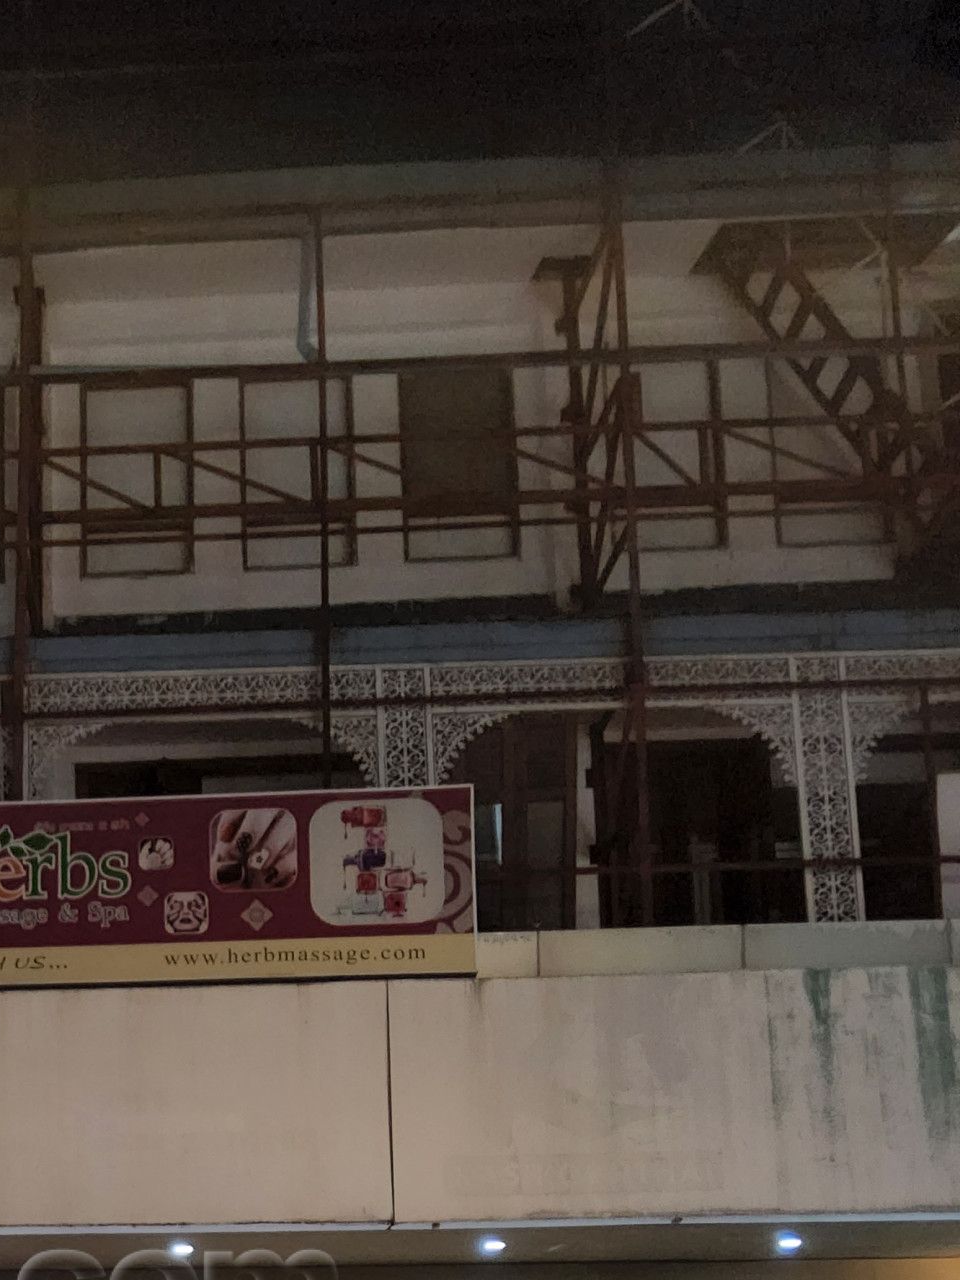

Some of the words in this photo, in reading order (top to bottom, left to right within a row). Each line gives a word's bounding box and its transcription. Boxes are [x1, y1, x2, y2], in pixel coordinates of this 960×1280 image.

[58, 903, 78, 923] &
[87, 902, 130, 928] Spa
[164, 946, 427, 967] www.herbmassage.com
